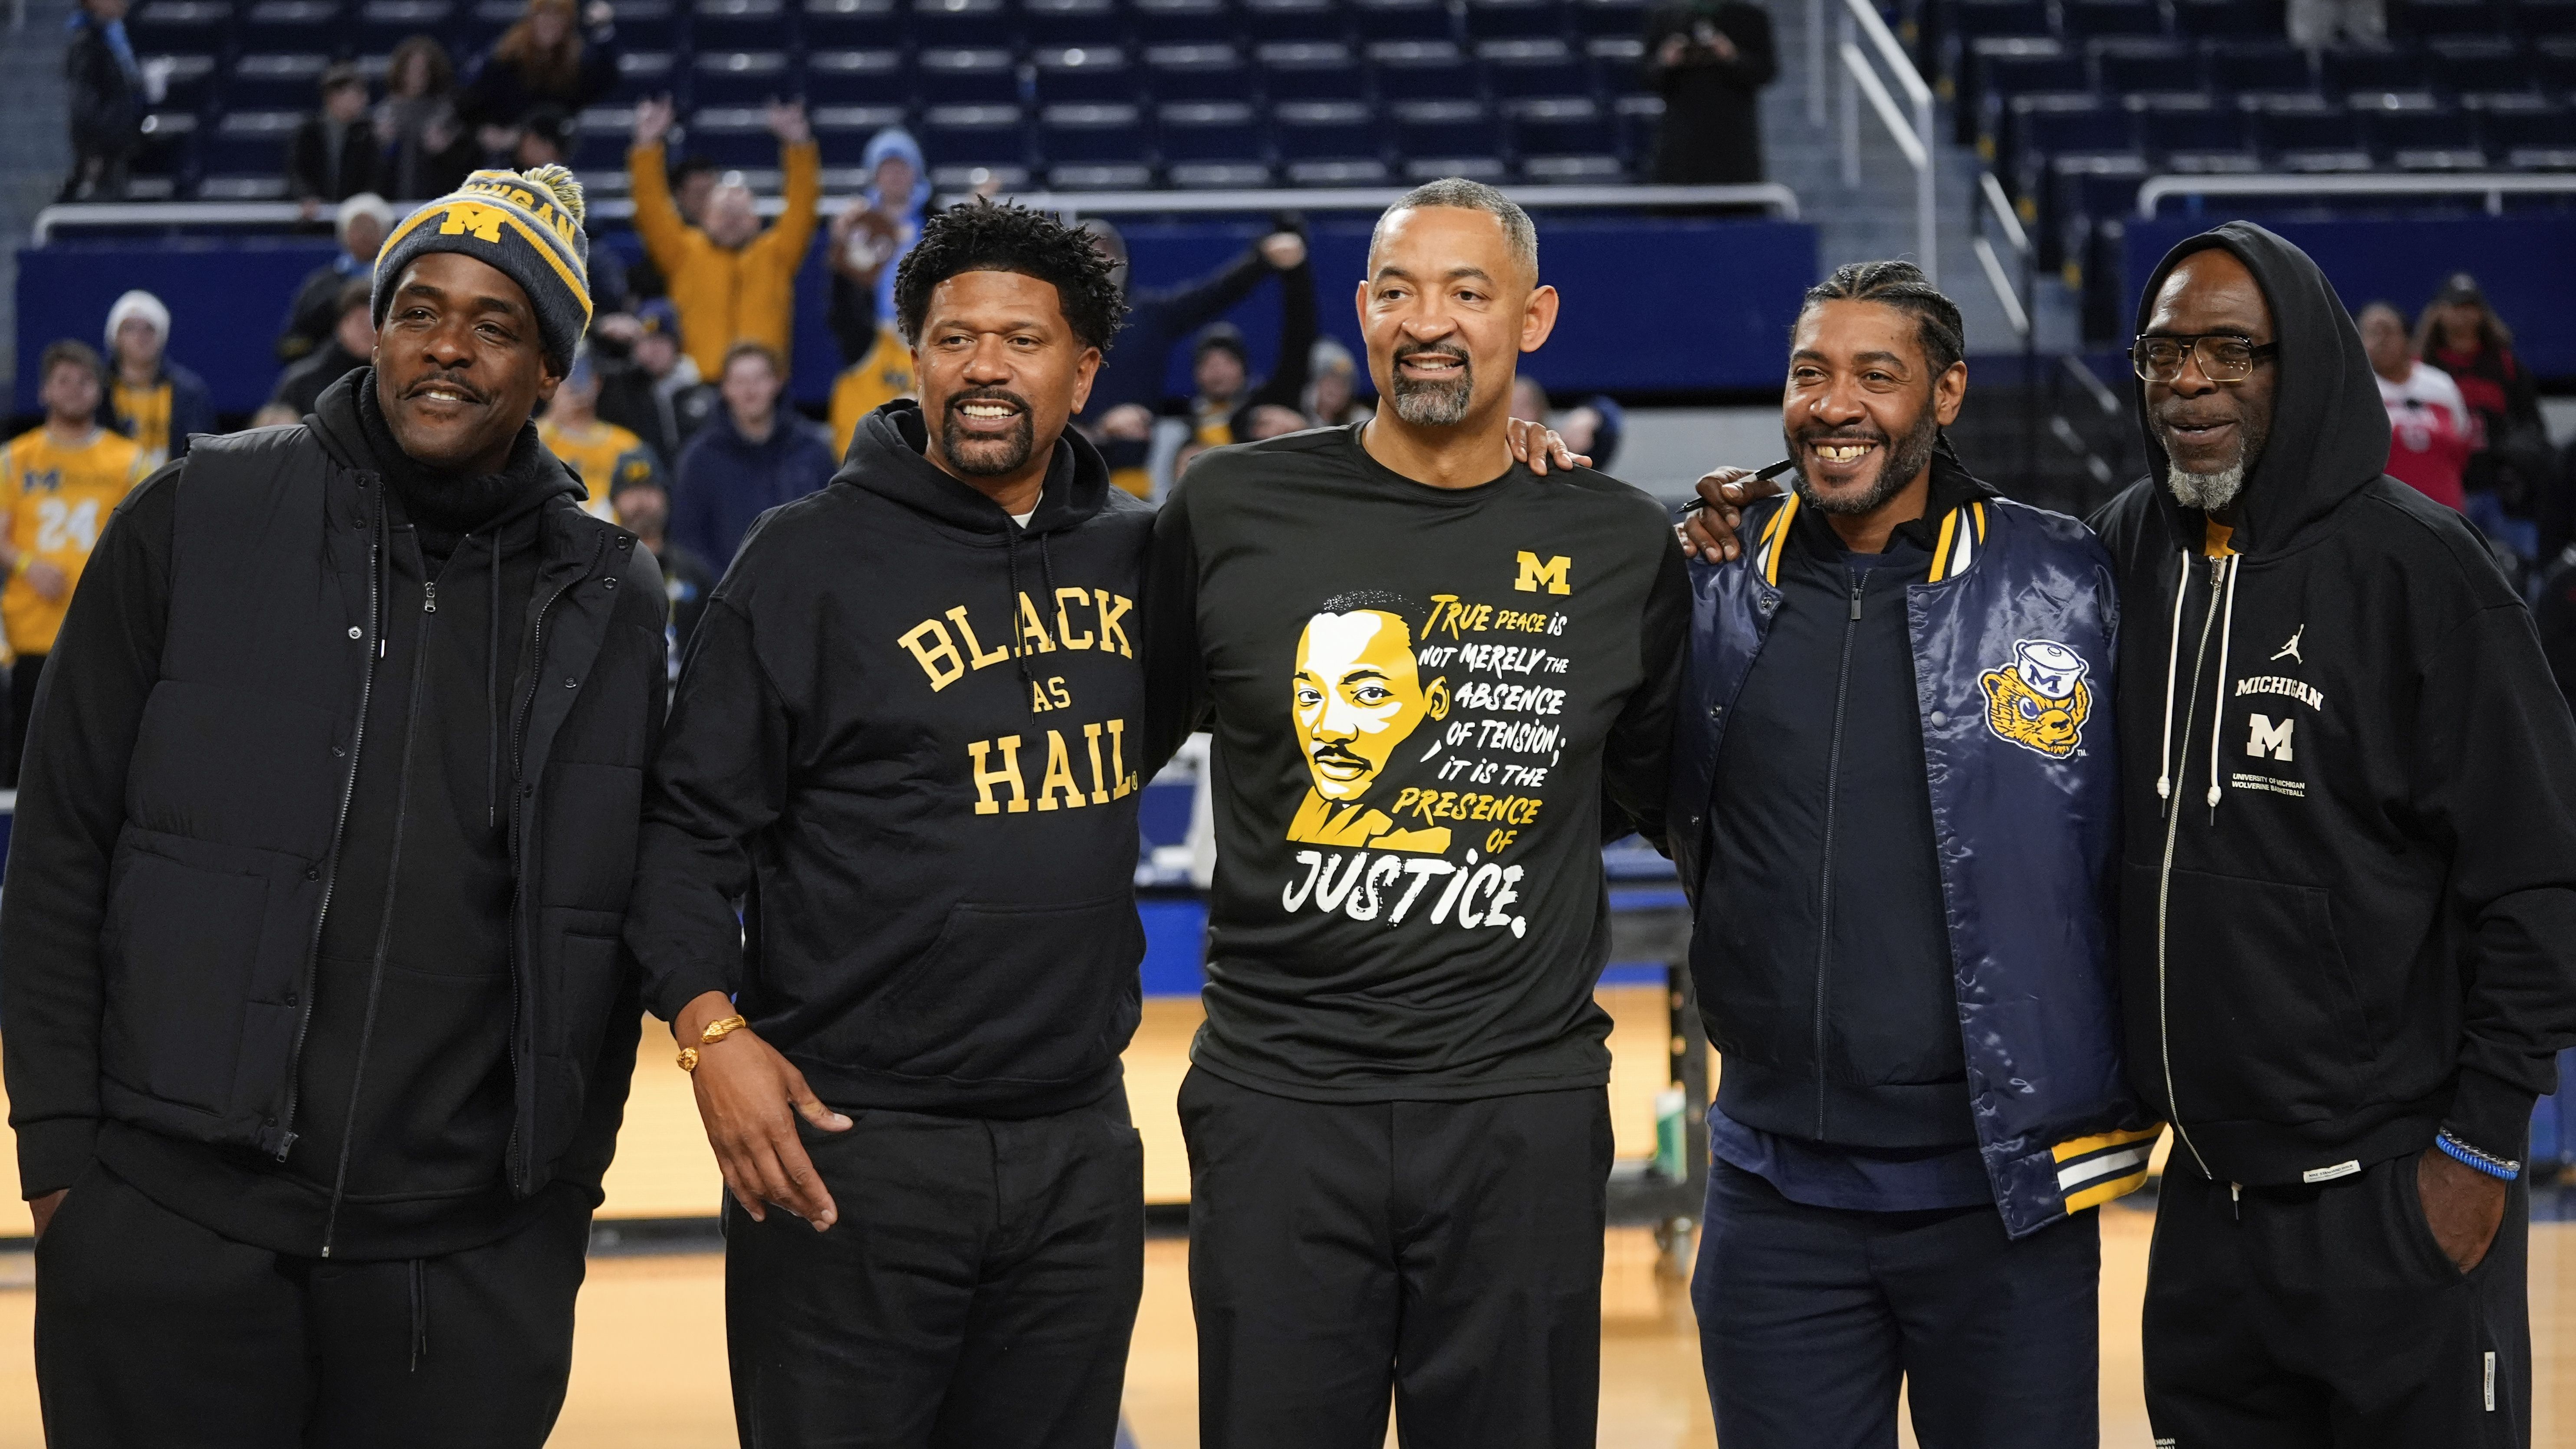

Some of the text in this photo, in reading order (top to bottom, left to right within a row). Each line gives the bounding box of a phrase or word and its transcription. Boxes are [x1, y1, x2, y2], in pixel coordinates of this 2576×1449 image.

[440, 206, 507, 243] M
[37, 498, 99, 552] 24
[1515, 551, 1571, 595] M
[1420, 594, 1493, 641] TRUE
[1494, 610, 1547, 633] PEACE
[897, 587, 1133, 693] BLACK
[1418, 642, 1569, 679] NOT MERELY THE
[2027, 664, 2062, 693] M
[1032, 676, 1071, 713] AS
[1454, 681, 1567, 715] ABSENCE
[2235, 676, 2324, 712] MICHIGAN
[1446, 720, 1475, 746] OF
[2247, 713, 2294, 762] M
[1500, 765, 1548, 787] THE
[2231, 781, 2305, 797] WOLVERINE BASKETBALL
[2232, 773, 2267, 783] UNIVERSITY
[2276, 779, 2305, 789] MICHIGAN
[1392, 788, 1543, 826] PRESENCE
[1485, 828, 1518, 854] OF
